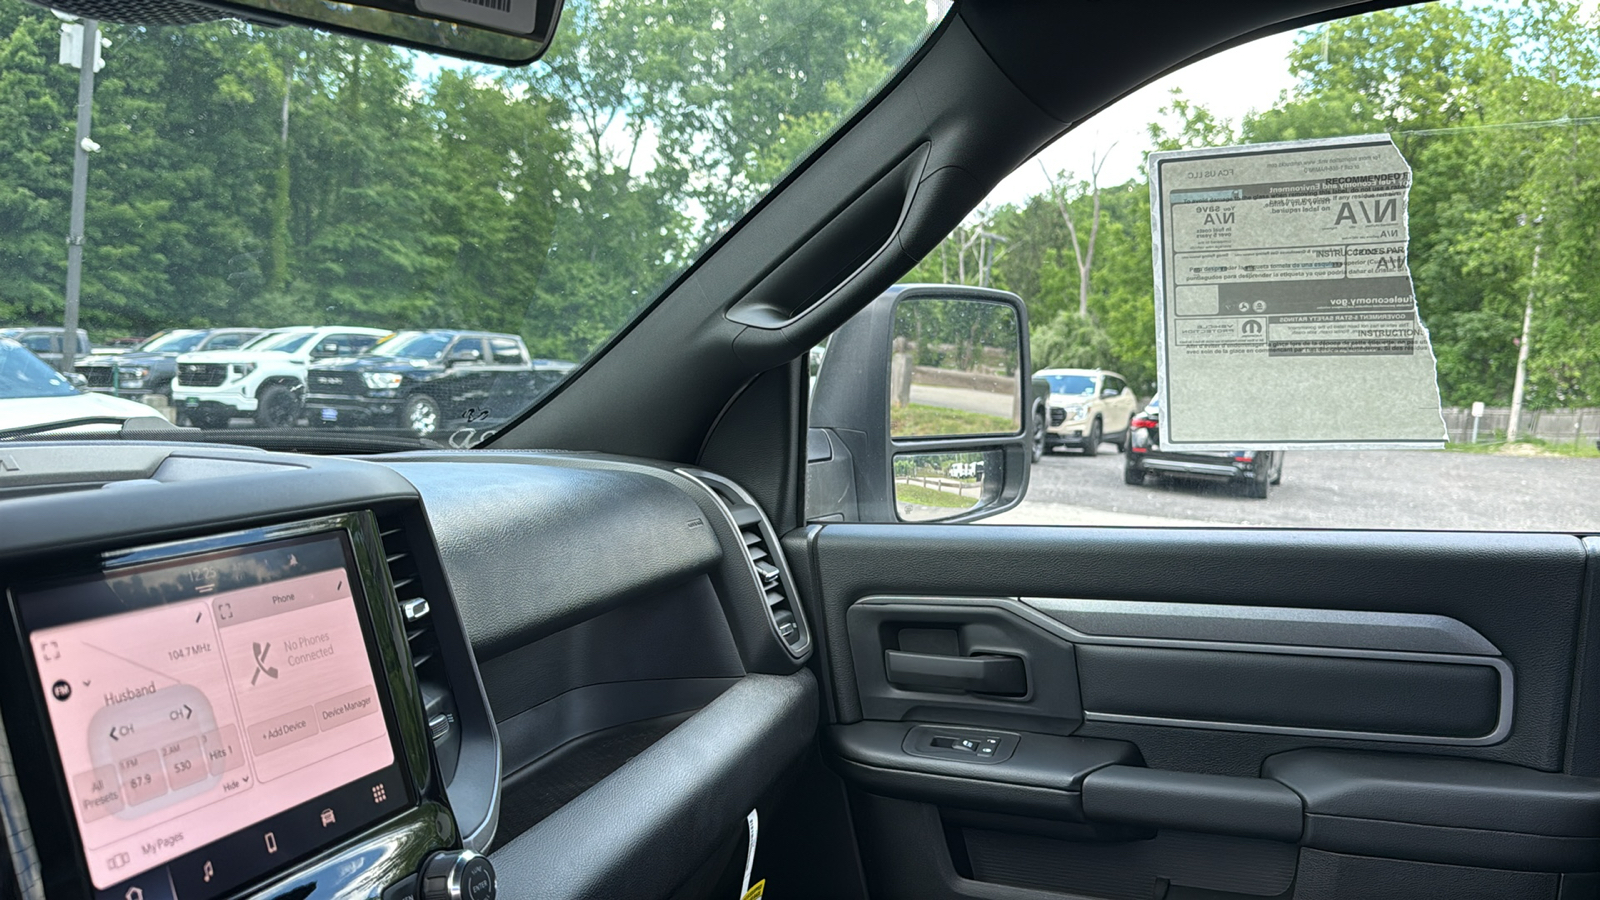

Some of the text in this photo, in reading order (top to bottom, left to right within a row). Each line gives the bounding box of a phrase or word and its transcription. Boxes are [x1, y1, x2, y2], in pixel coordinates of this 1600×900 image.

[1325, 172, 1401, 185] RECOMMENDED
[1288, 190, 1318, 198] removing
[272, 592, 295, 605] Phone
[284, 632, 330, 653] No Phones
[168, 643, 212, 661] 104.7 MHz
[287, 643, 335, 667] Connected
[54, 683, 70, 697] FM
[103, 680, 157, 707] Husband
[169, 708, 184, 721] CH
[322, 696, 372, 720] Device Manager
[118, 723, 135, 738] CH
[267, 719, 307, 740] Add Device
[209, 748, 227, 761] Hits
[173, 759, 192, 774] 530
[91, 779, 104, 794] All
[223, 779, 240, 793] Hide
[83, 791, 119, 810] Presets
[141, 830, 185, 857] My Pages
[472, 880, 488, 894] ENTER
